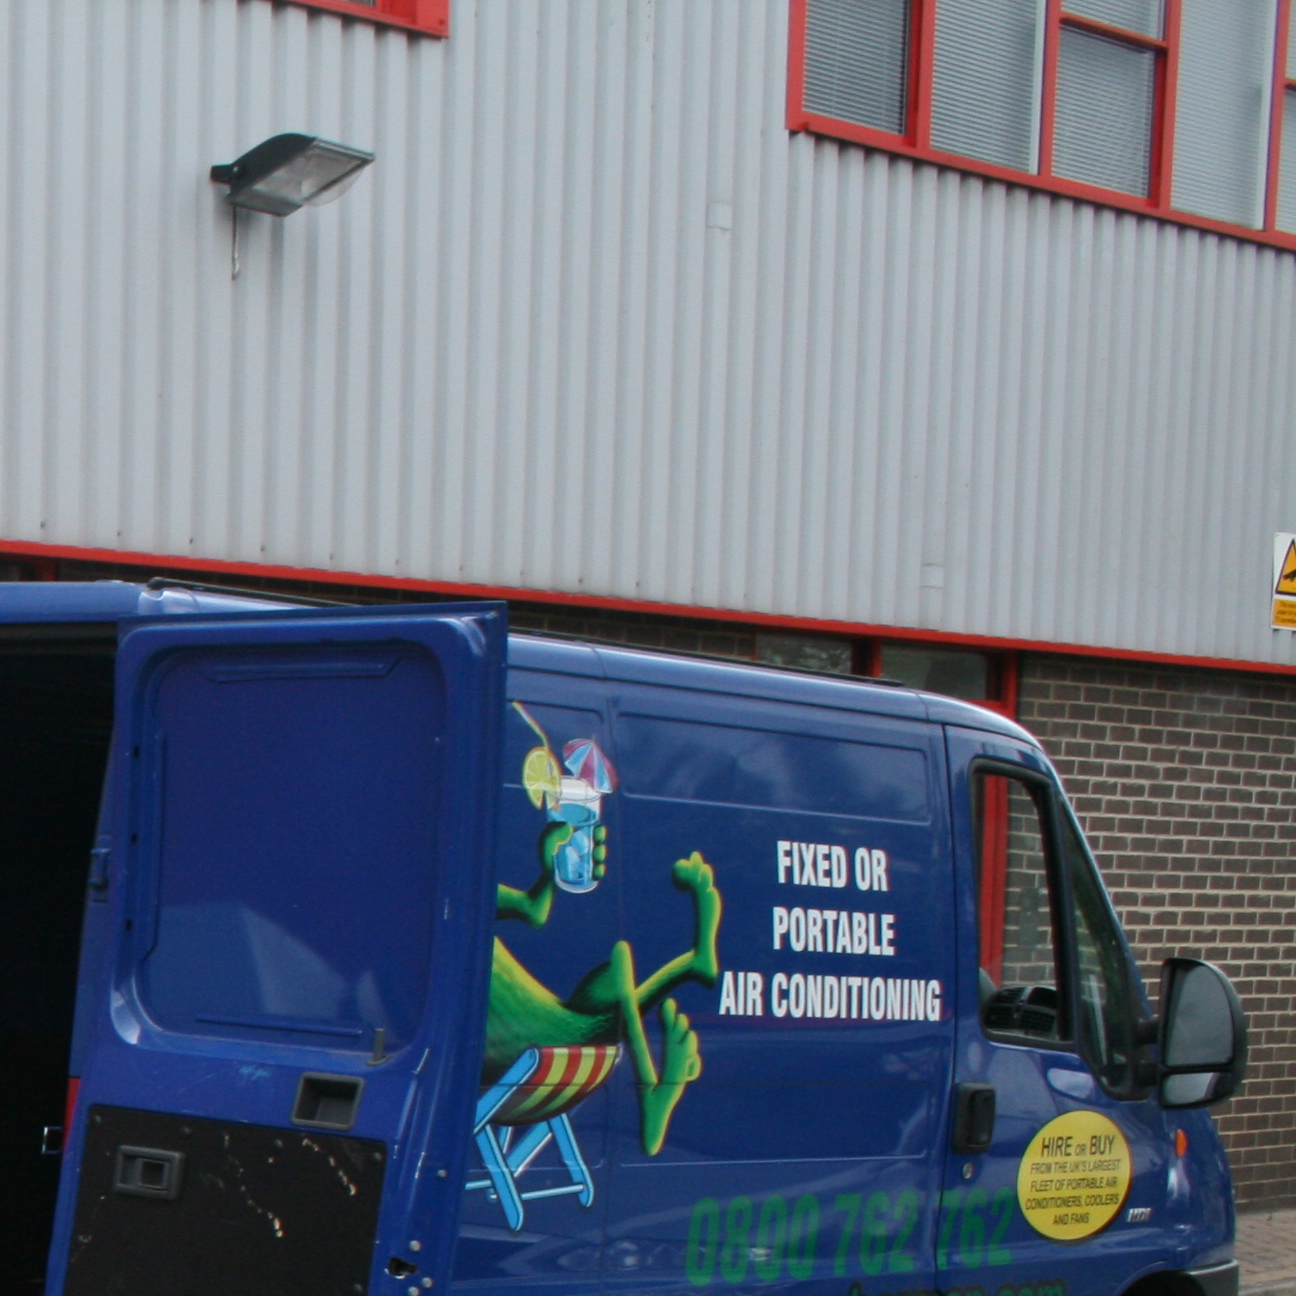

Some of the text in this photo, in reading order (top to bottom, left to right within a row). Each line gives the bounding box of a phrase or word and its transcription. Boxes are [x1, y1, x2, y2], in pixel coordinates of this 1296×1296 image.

[776, 840, 890, 891] FIXED OR
[772, 906, 896, 956] PORTABLE
[718, 971, 942, 1022] AIR CONDITIONING
[1041, 1135, 1115, 1157] HIRE OR BUY
[1030, 1162, 1052, 1175] FROM
[1053, 1161, 1068, 1173] THE
[1088, 1159, 1121, 1172] LARGEST
[1030, 1176, 1118, 1192] FLEET OF PORTABLE AIR
[1084, 1193, 1119, 1207] COOLERS
[1052, 1212, 1090, 1225] AND FANS
[685, 1187, 1014, 1287] 0800 762 762
